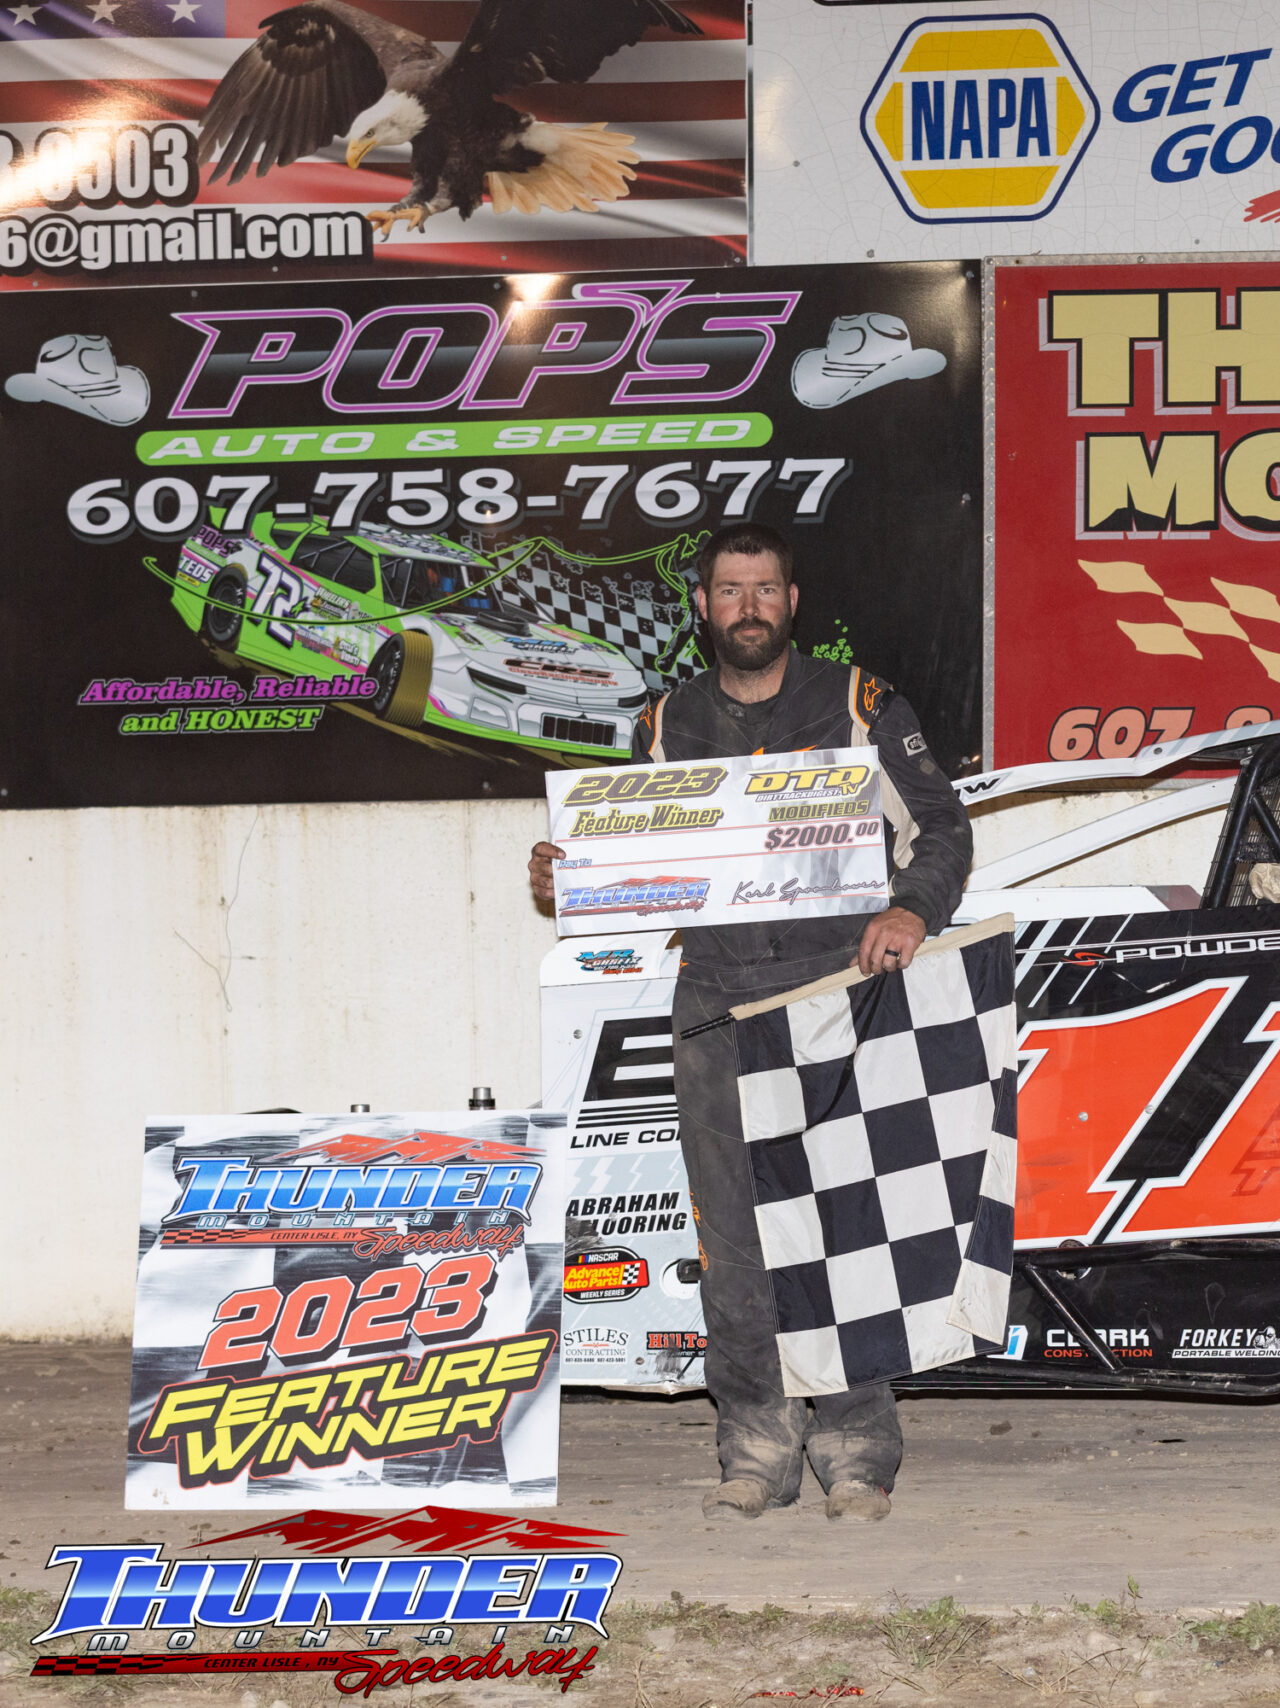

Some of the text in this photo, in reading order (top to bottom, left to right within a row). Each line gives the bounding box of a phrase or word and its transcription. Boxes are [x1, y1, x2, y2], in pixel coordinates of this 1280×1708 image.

[1112, 49, 1269, 123] GET
[911, 79, 1051, 161] NAPA
[146, 418, 752, 460] AUTO & SPEED
[66, 458, 844, 535] 607-758-7677
[80, 680, 246, 703] Affordable,
[251, 675, 378, 699] Reliable
[121, 707, 323, 733] and HONEST
[562, 766, 728, 806] 2023
[745, 765, 870, 794] DTD
[569, 802, 724, 837] Feature Winner
[769, 800, 870, 822] MODIFIEDS
[570, 1132, 629, 1149] LINE
[162, 1157, 542, 1224] THUNDER
[566, 1192, 680, 1216] ABRAHAM
[198, 1211, 510, 1228] MOUNTAIN
[270, 1232, 309, 1241] CENTER
[353, 1224, 523, 1260] Speedway
[588, 1252, 618, 1262] NASCAR
[564, 1277, 618, 1289] Auto Parts
[566, 1266, 619, 1280] Advance
[197, 1254, 496, 1370] 2023
[563, 1327, 629, 1346] STILES
[1179, 1328, 1257, 1347] FORKEY
[148, 1337, 553, 1440] FEATURE
[186, 1389, 507, 1476] WINNER
